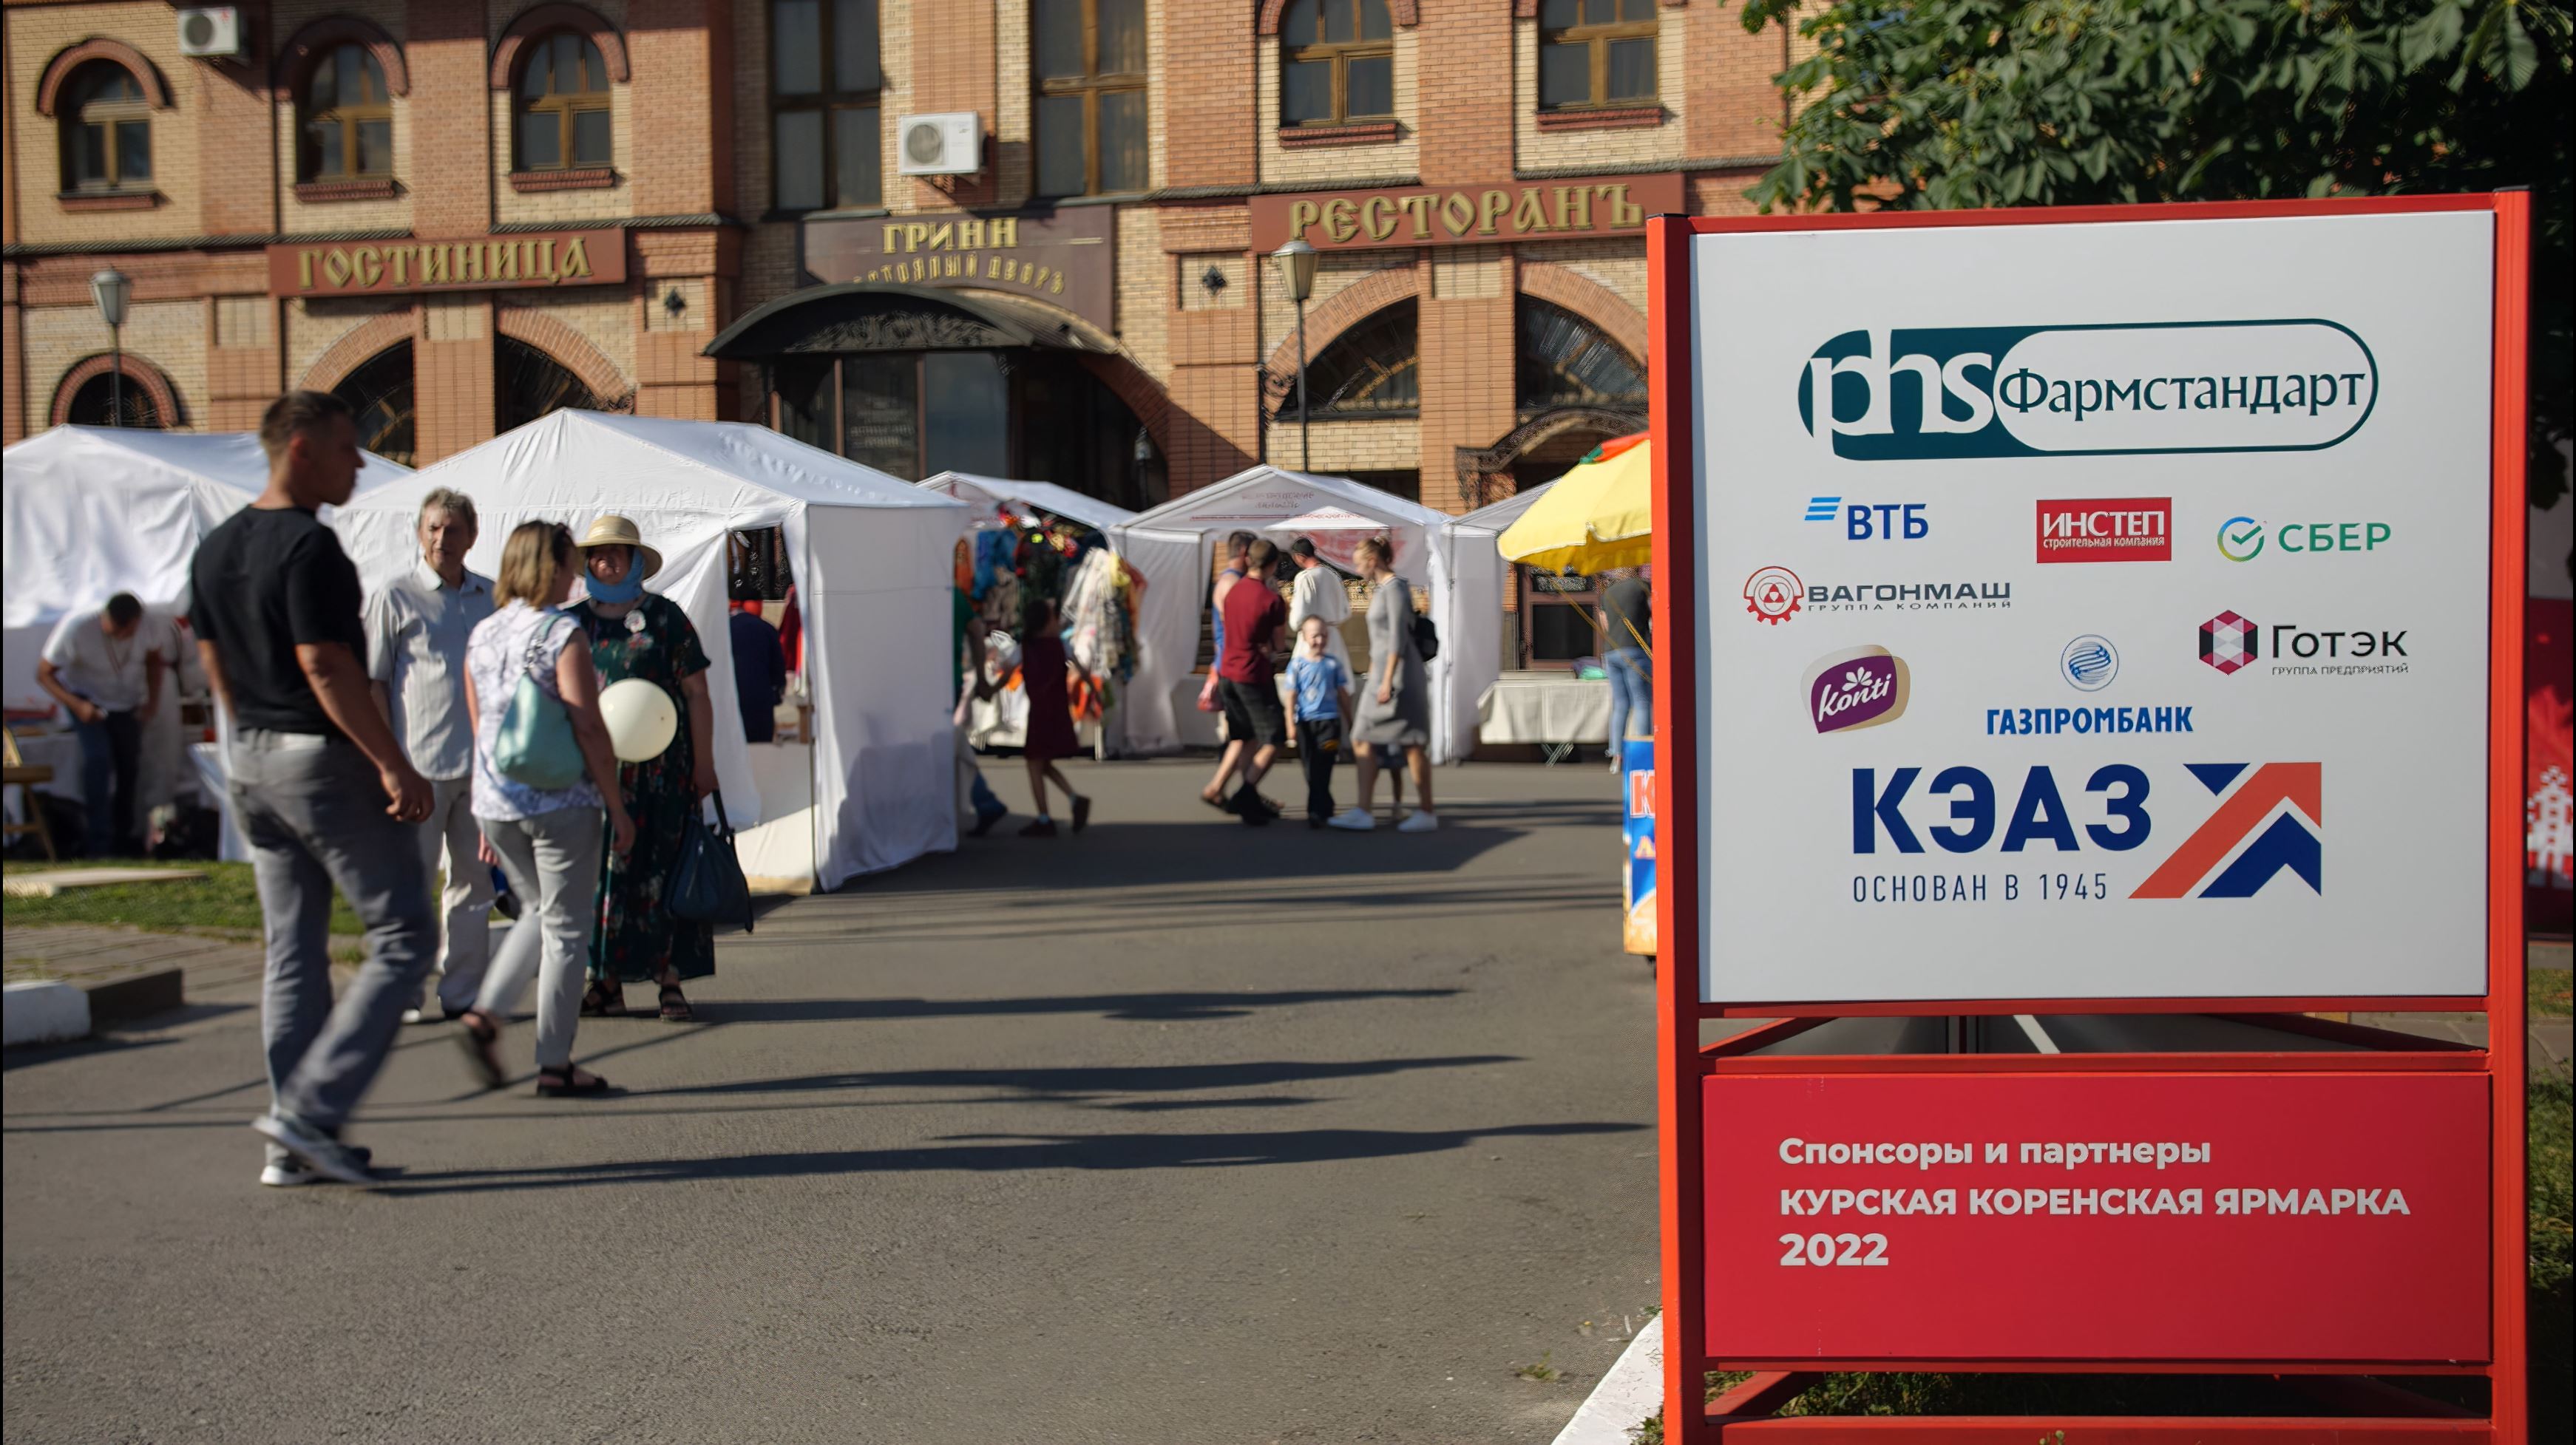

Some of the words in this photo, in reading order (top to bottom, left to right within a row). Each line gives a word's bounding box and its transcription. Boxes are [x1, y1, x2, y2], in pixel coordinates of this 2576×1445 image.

[1289, 183, 1645, 242] РЕСТОРАНЪ
[882, 217, 1019, 253] ГРИНН
[299, 236, 592, 289] ГОСТИНИЦА
[1809, 329, 1994, 447] phs
[1999, 368, 2366, 421] Фармстандарт
[1848, 503, 1929, 540] ВТБ
[2043, 511, 2165, 537] ИНСТЕП
[2277, 522, 2392, 553] СБЕР
[2043, 537, 2112, 551] строительная
[2114, 537, 2165, 547] компания
[1809, 582, 2010, 602] ВАГОНМАШ
[1809, 603, 1882, 611] ГРУППА
[1897, 600, 2011, 611] КОМПАНИЙ
[2272, 666, 2318, 676] ГРУППА
[2321, 662, 2409, 676] ПРЕДПРИЯТИЙ
[1986, 707, 2194, 735] ГАЗПРОМБАНК
[1852, 764, 2152, 854] КЭАЗ
[1853, 874, 1987, 902] ОСНОВАН
[2004, 874, 2019, 900] В
[2038, 873, 2106, 900] 1945
[1779, 1138, 1973, 1171] Спонсоры
[1985, 1143, 2007, 1164] и
[2020, 1143, 2211, 1171] партнеры
[1780, 1189, 1957, 1216] КУРСКАЯ
[1969, 1188, 2203, 1216] КОРЕНСКАЯ
[2214, 1188, 2411, 1216] ЯРМАРКА
[1779, 1233, 1889, 1266] 2022
